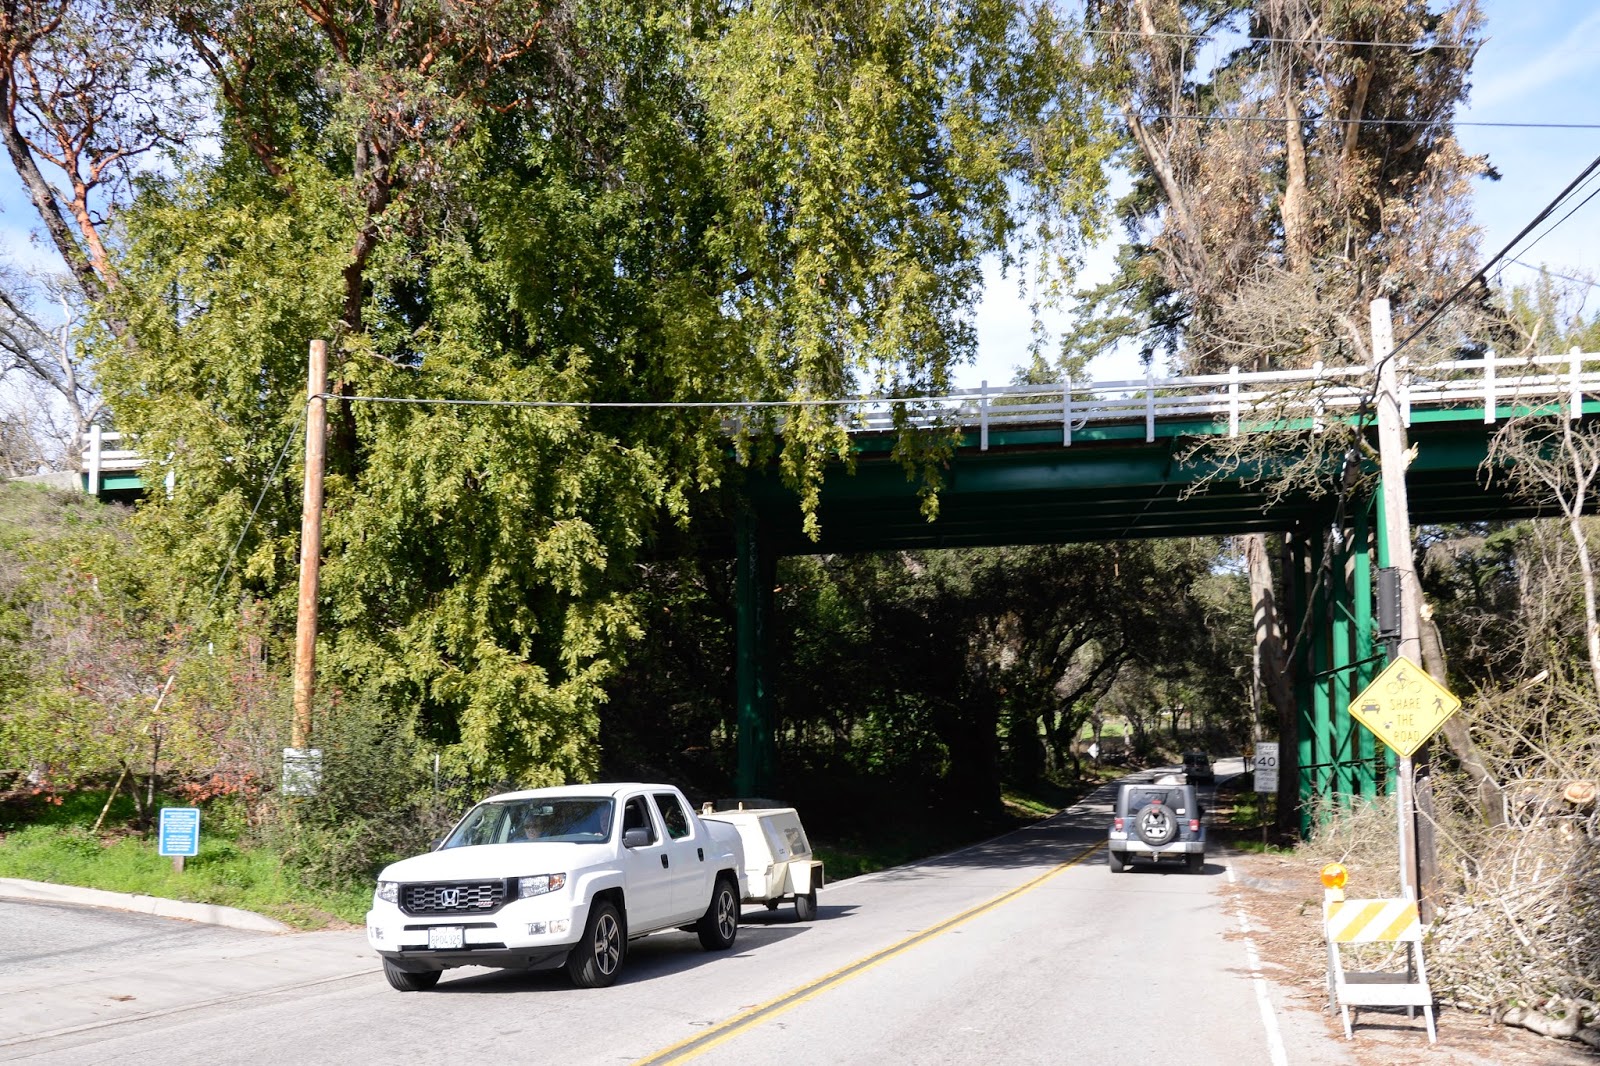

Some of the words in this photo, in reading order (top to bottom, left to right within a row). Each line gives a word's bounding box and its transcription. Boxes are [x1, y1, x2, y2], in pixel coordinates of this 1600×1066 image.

[1390, 698, 1421, 710] SHARE
[1397, 714, 1414, 726] THE
[1394, 731, 1420, 742] ROAD
[1257, 756, 1276, 767] 40
